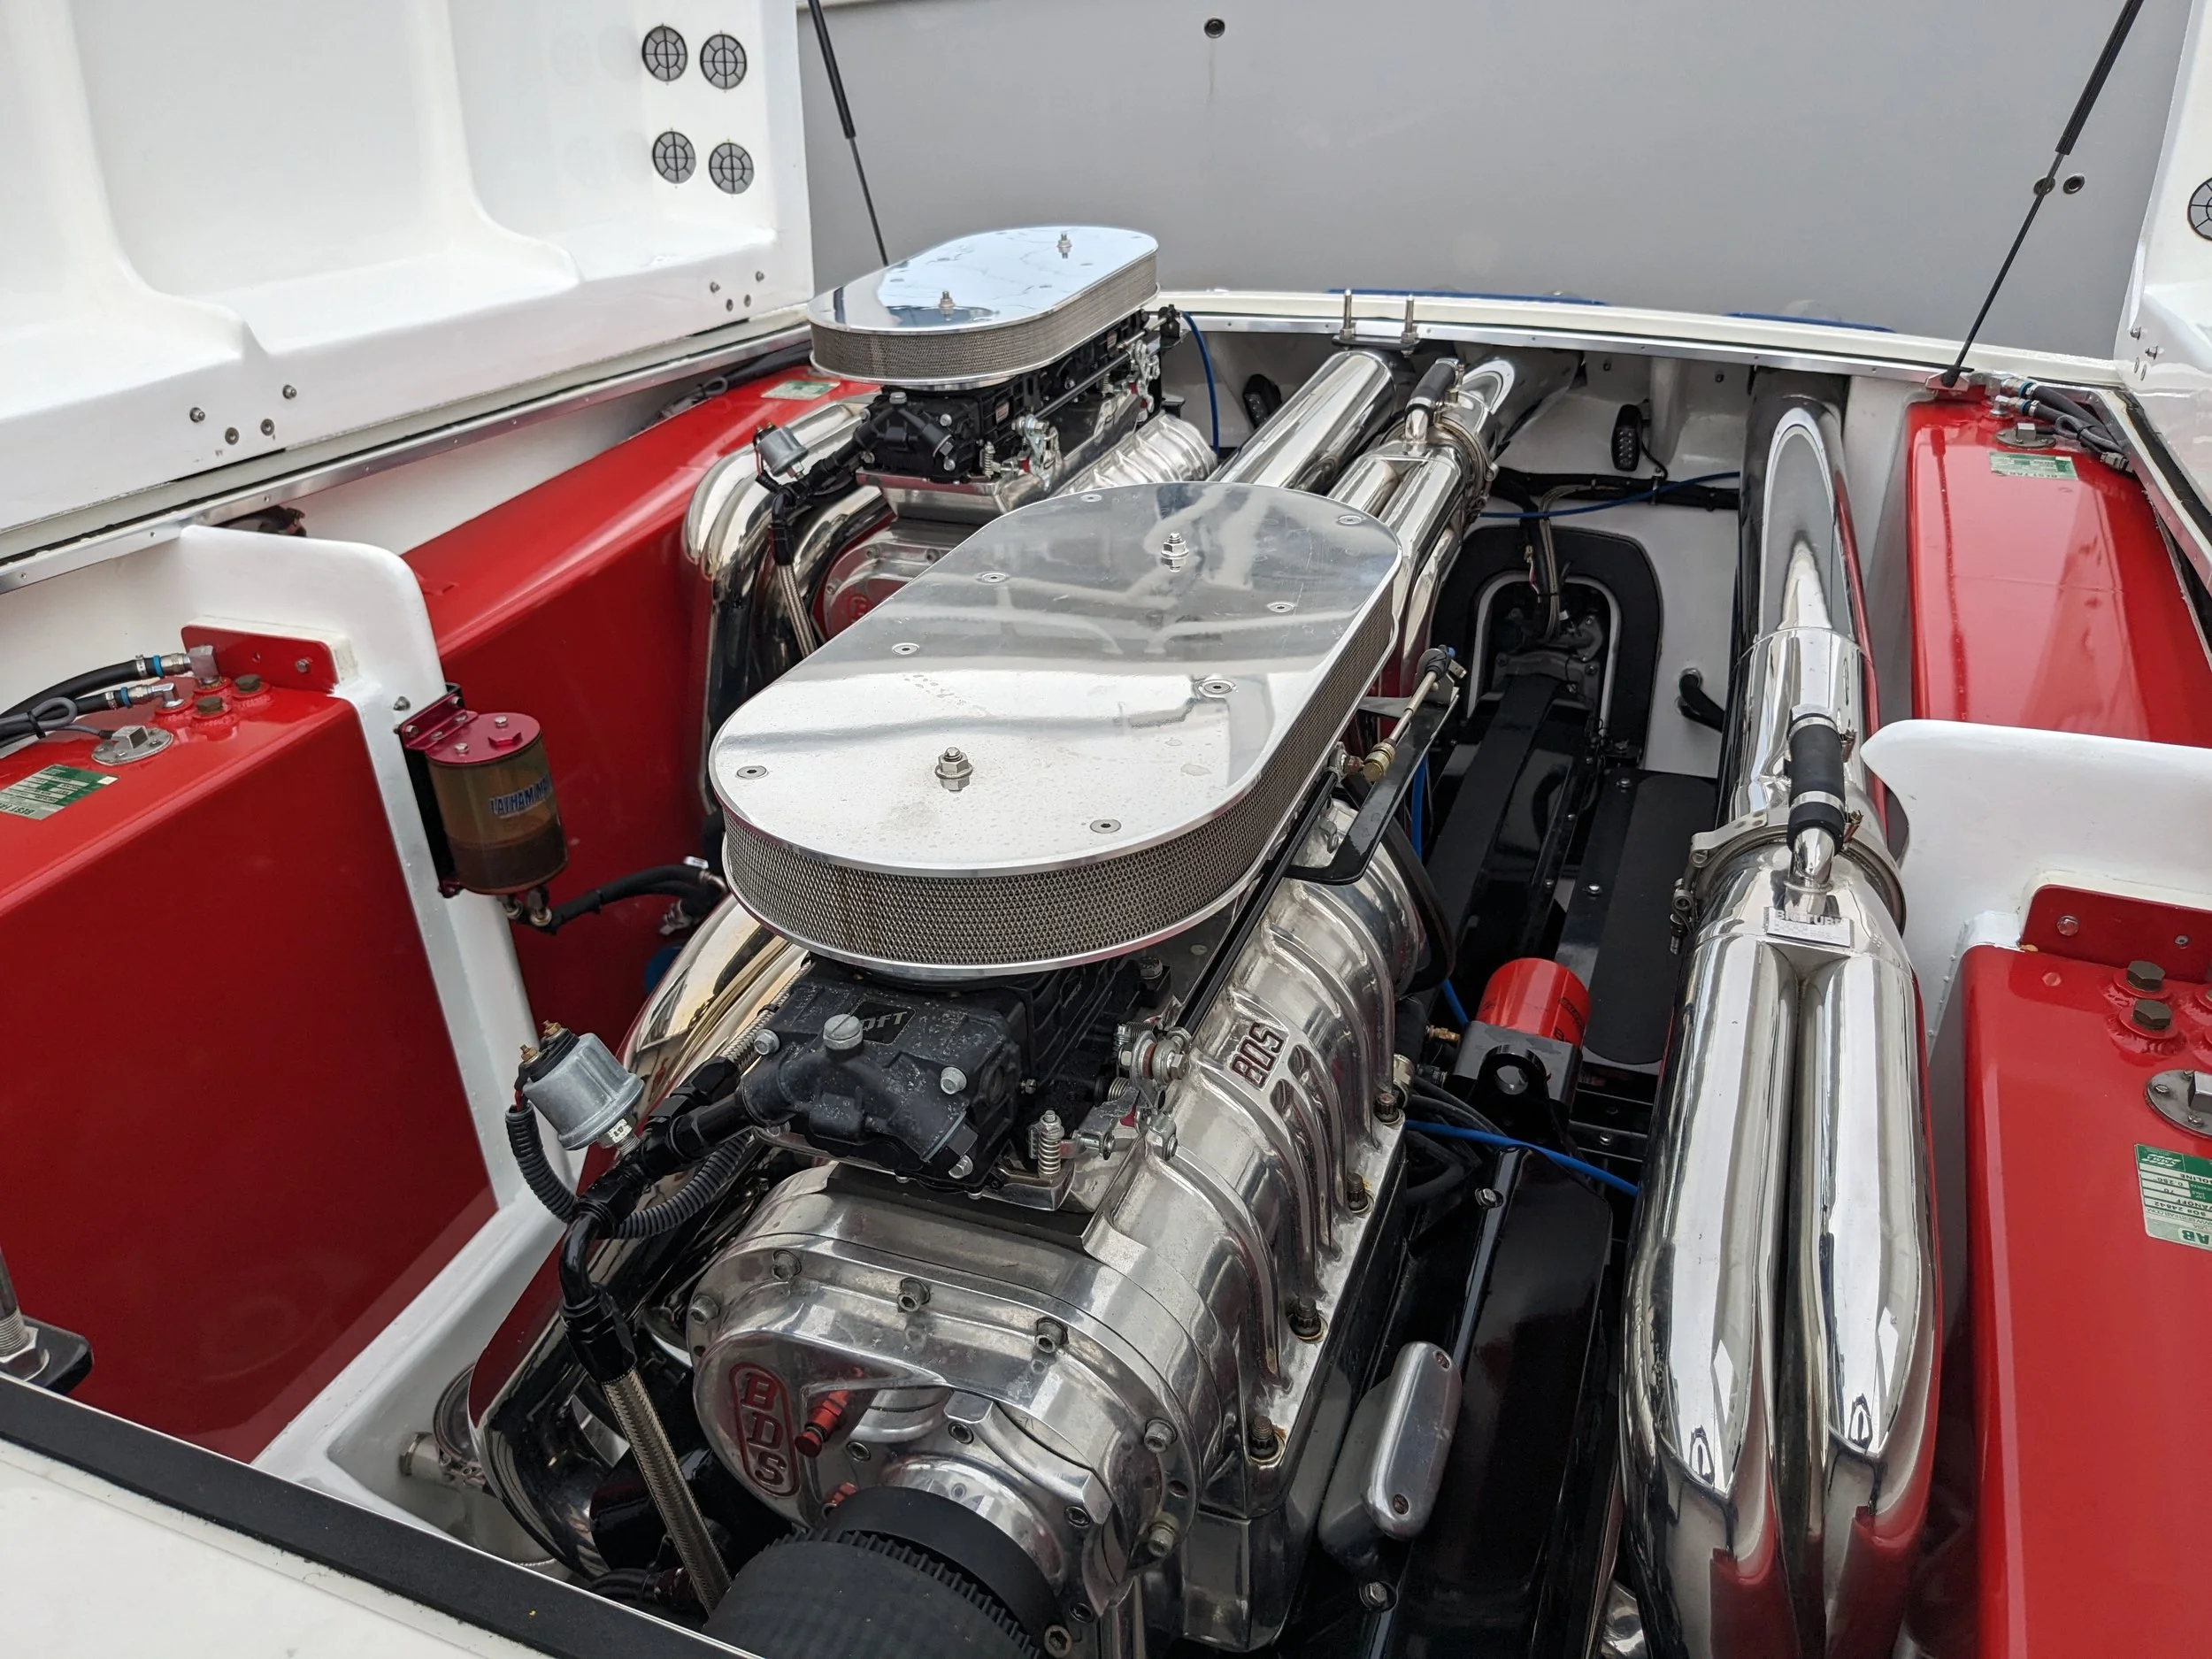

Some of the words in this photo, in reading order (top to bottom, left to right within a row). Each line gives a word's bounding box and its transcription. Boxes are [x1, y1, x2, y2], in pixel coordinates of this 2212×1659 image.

[1229, 1020, 1286, 1090] BDS
[2182, 1230, 2209, 1245] AB
[739, 1371, 787, 1486] BDS
